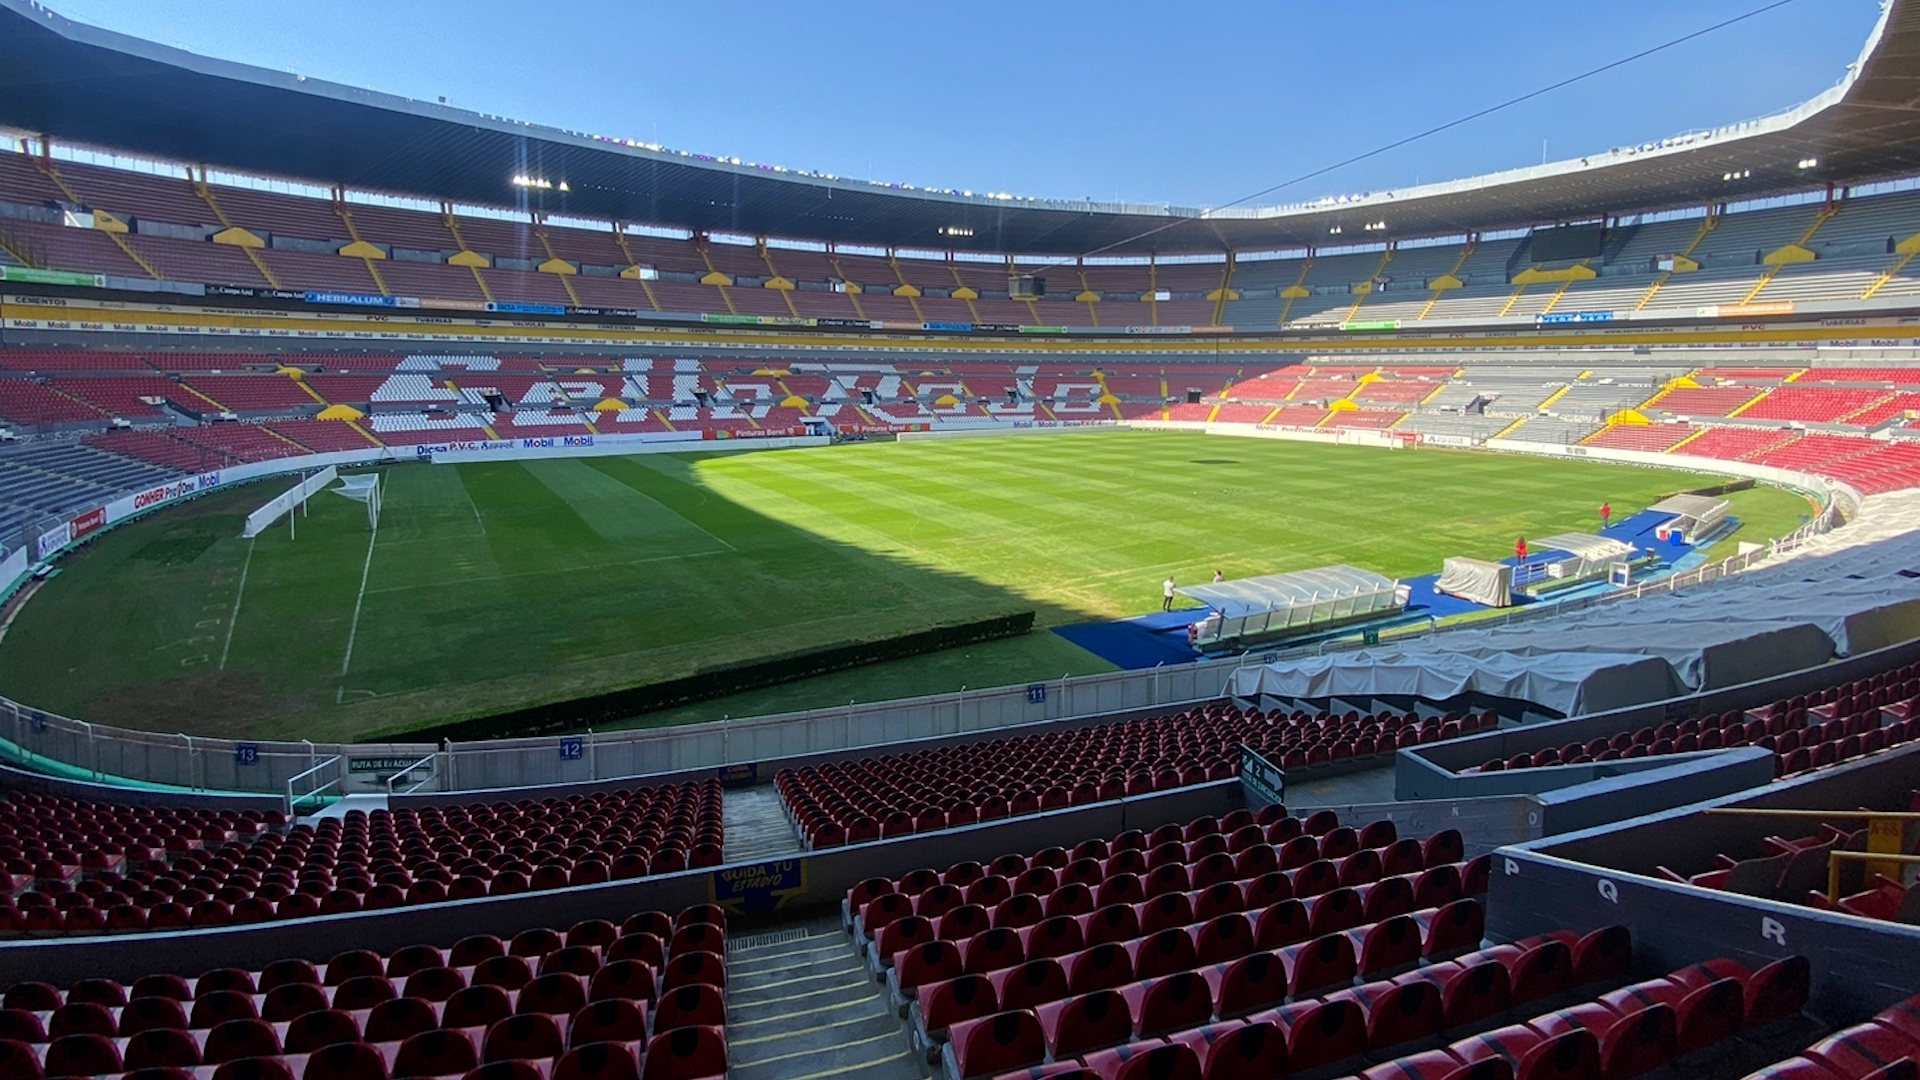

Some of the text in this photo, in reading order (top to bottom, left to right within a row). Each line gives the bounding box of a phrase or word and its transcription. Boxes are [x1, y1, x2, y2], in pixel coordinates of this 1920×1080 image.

[15, 296, 67, 306] CEMENTOS
[316, 293, 383, 305] HERRALUM
[14, 319, 38, 328] Mobil
[47, 321, 71, 329] Mobil
[80, 322, 104, 330] Mobil
[1741, 323, 1765, 331] PVC
[1871, 339, 1900, 347] Mobil
[523, 438, 554, 449] Mobil
[563, 436, 594, 447] Mobil
[199, 471, 220, 489] Mobil
[1031, 688, 1044, 700] 11
[240, 748, 255, 761] 13
[562, 743, 580, 756] 12
[352, 760, 372, 769] RUTA
[373, 760, 383, 768] DE
[773, 861, 793, 874] TU
[1504, 858, 1519, 876] P
[732, 874, 783, 893] ESTADIO
[1597, 879, 1619, 904] Q
[1761, 915, 1786, 946] R
